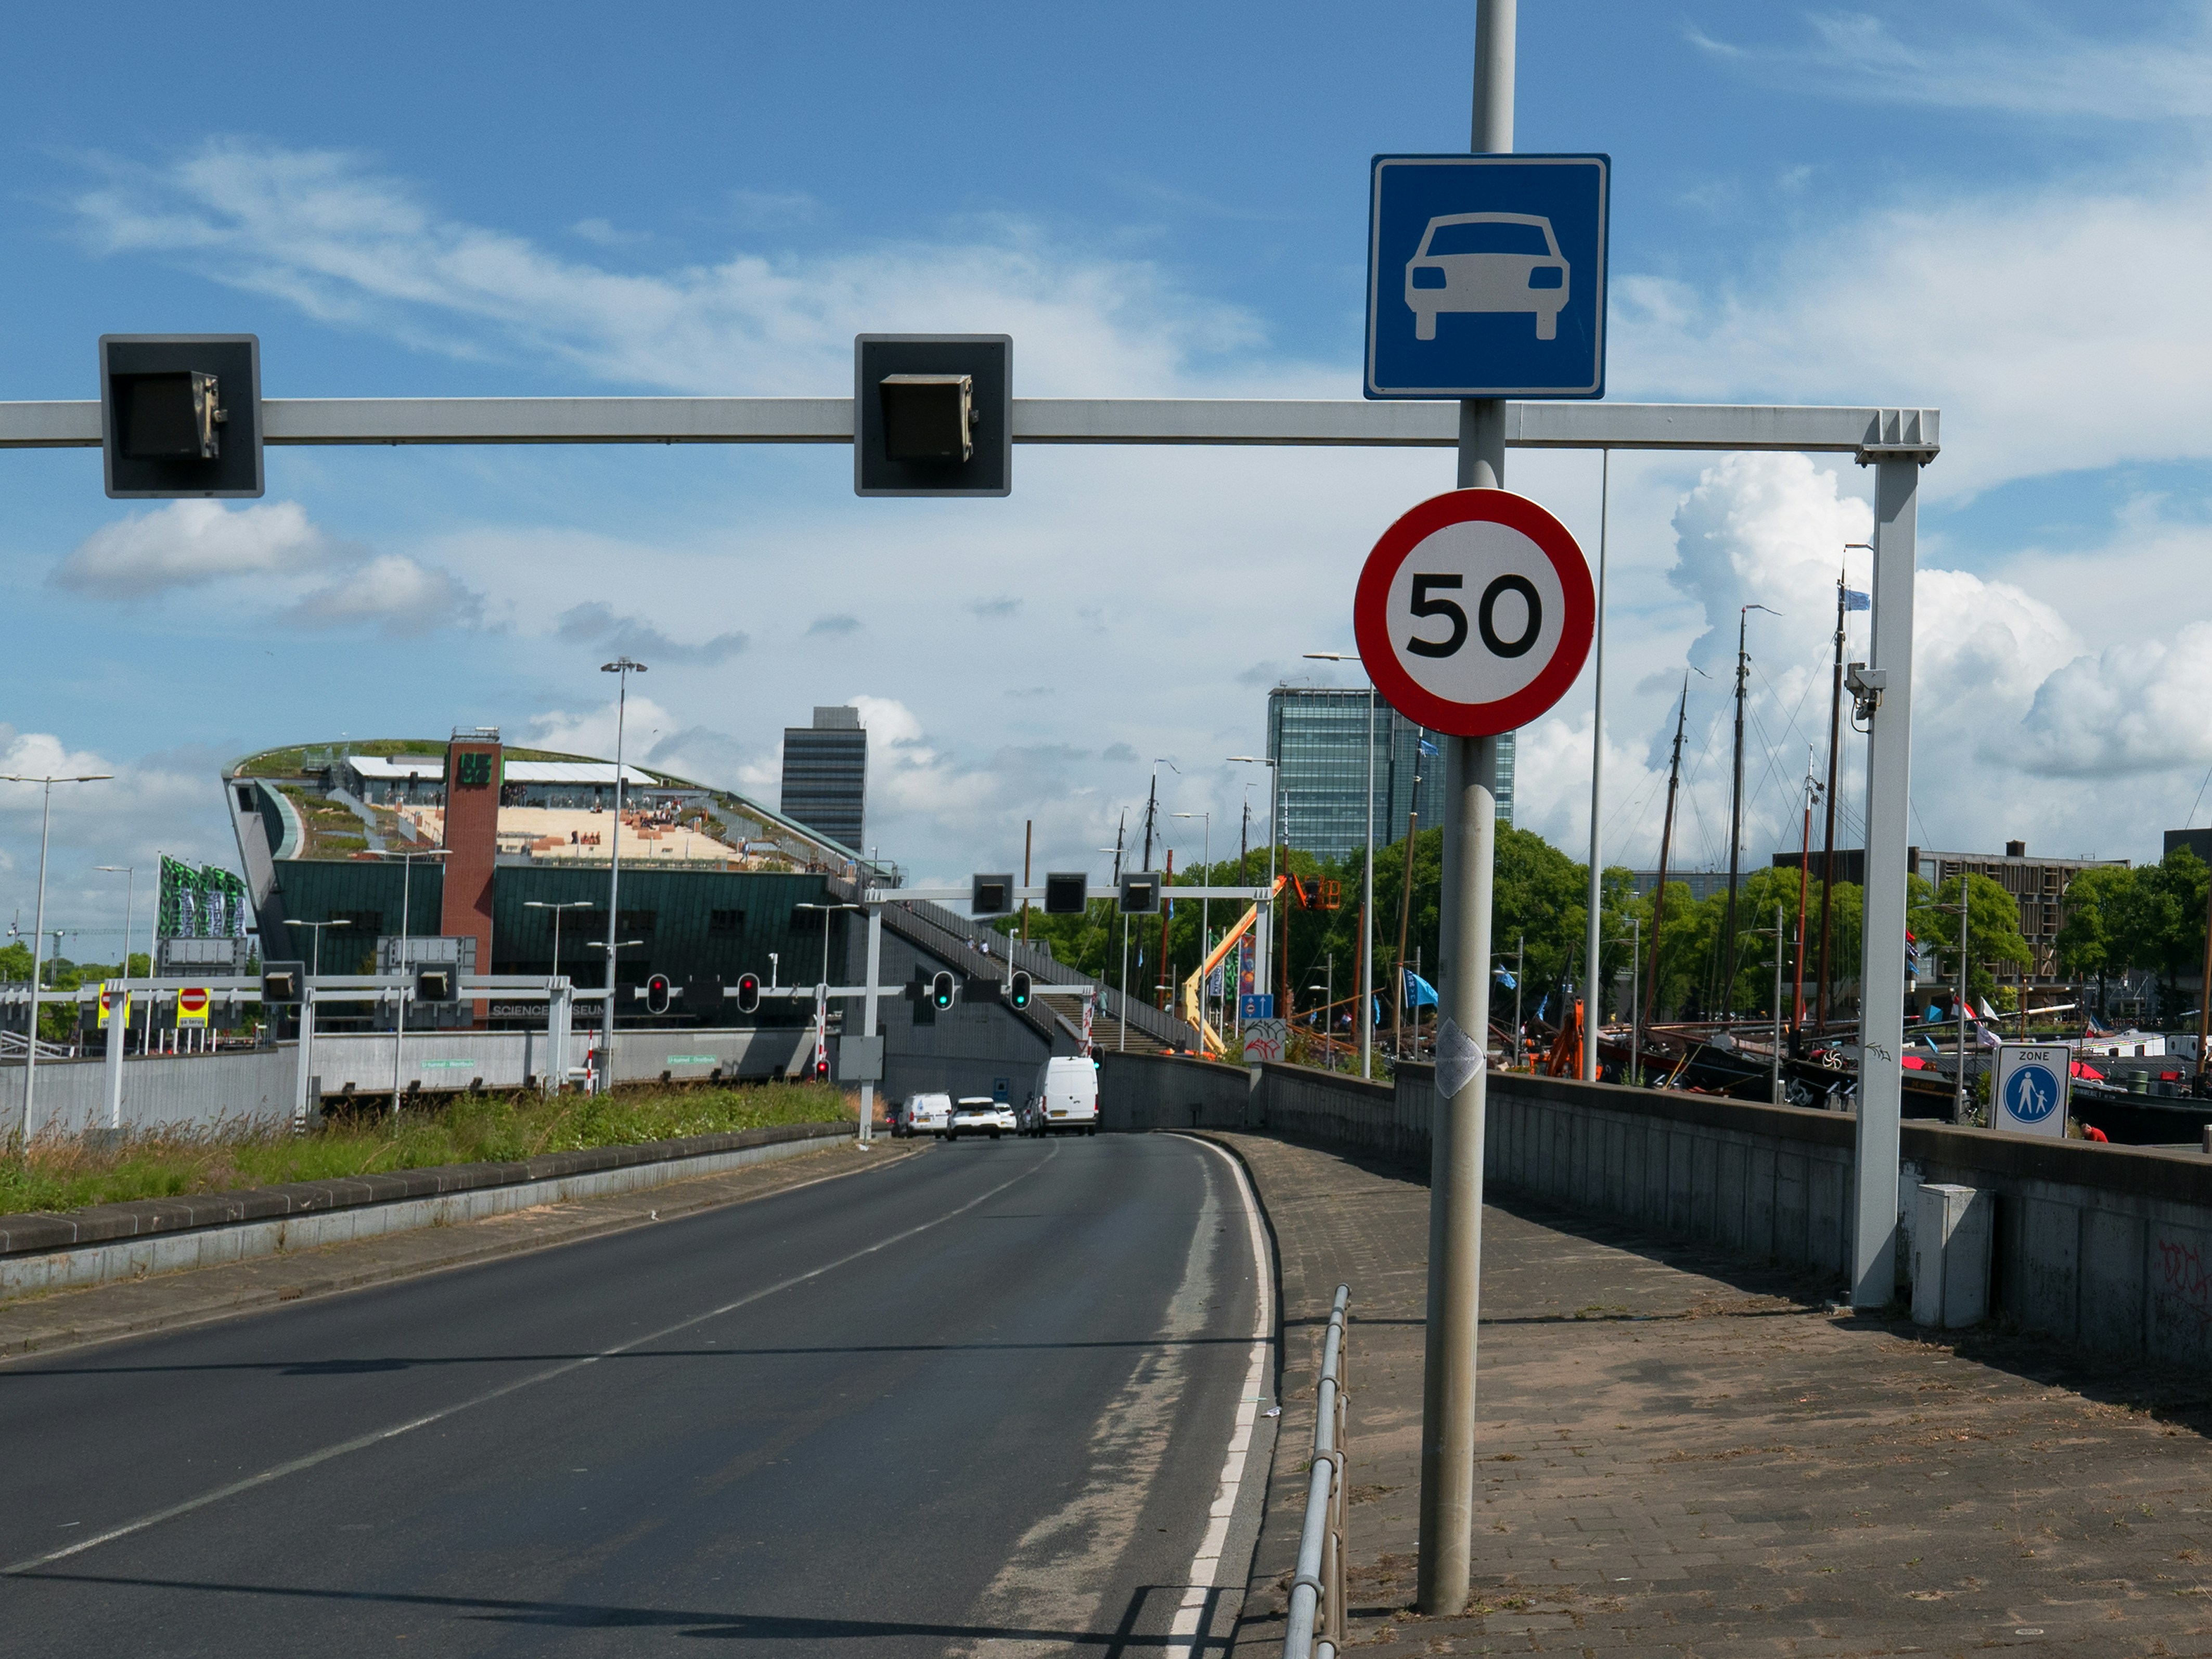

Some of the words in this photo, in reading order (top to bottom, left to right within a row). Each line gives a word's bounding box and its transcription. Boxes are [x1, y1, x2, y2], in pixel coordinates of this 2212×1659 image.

[1407, 573, 1542, 659] 50
[184, 889, 193, 937] SCIENC
[213, 892, 222, 936] SCIENC
[493, 1005, 549, 1016] SCIENCE
[573, 1005, 605, 1015] SEUM
[2019, 1051, 2050, 1061] ZONE
